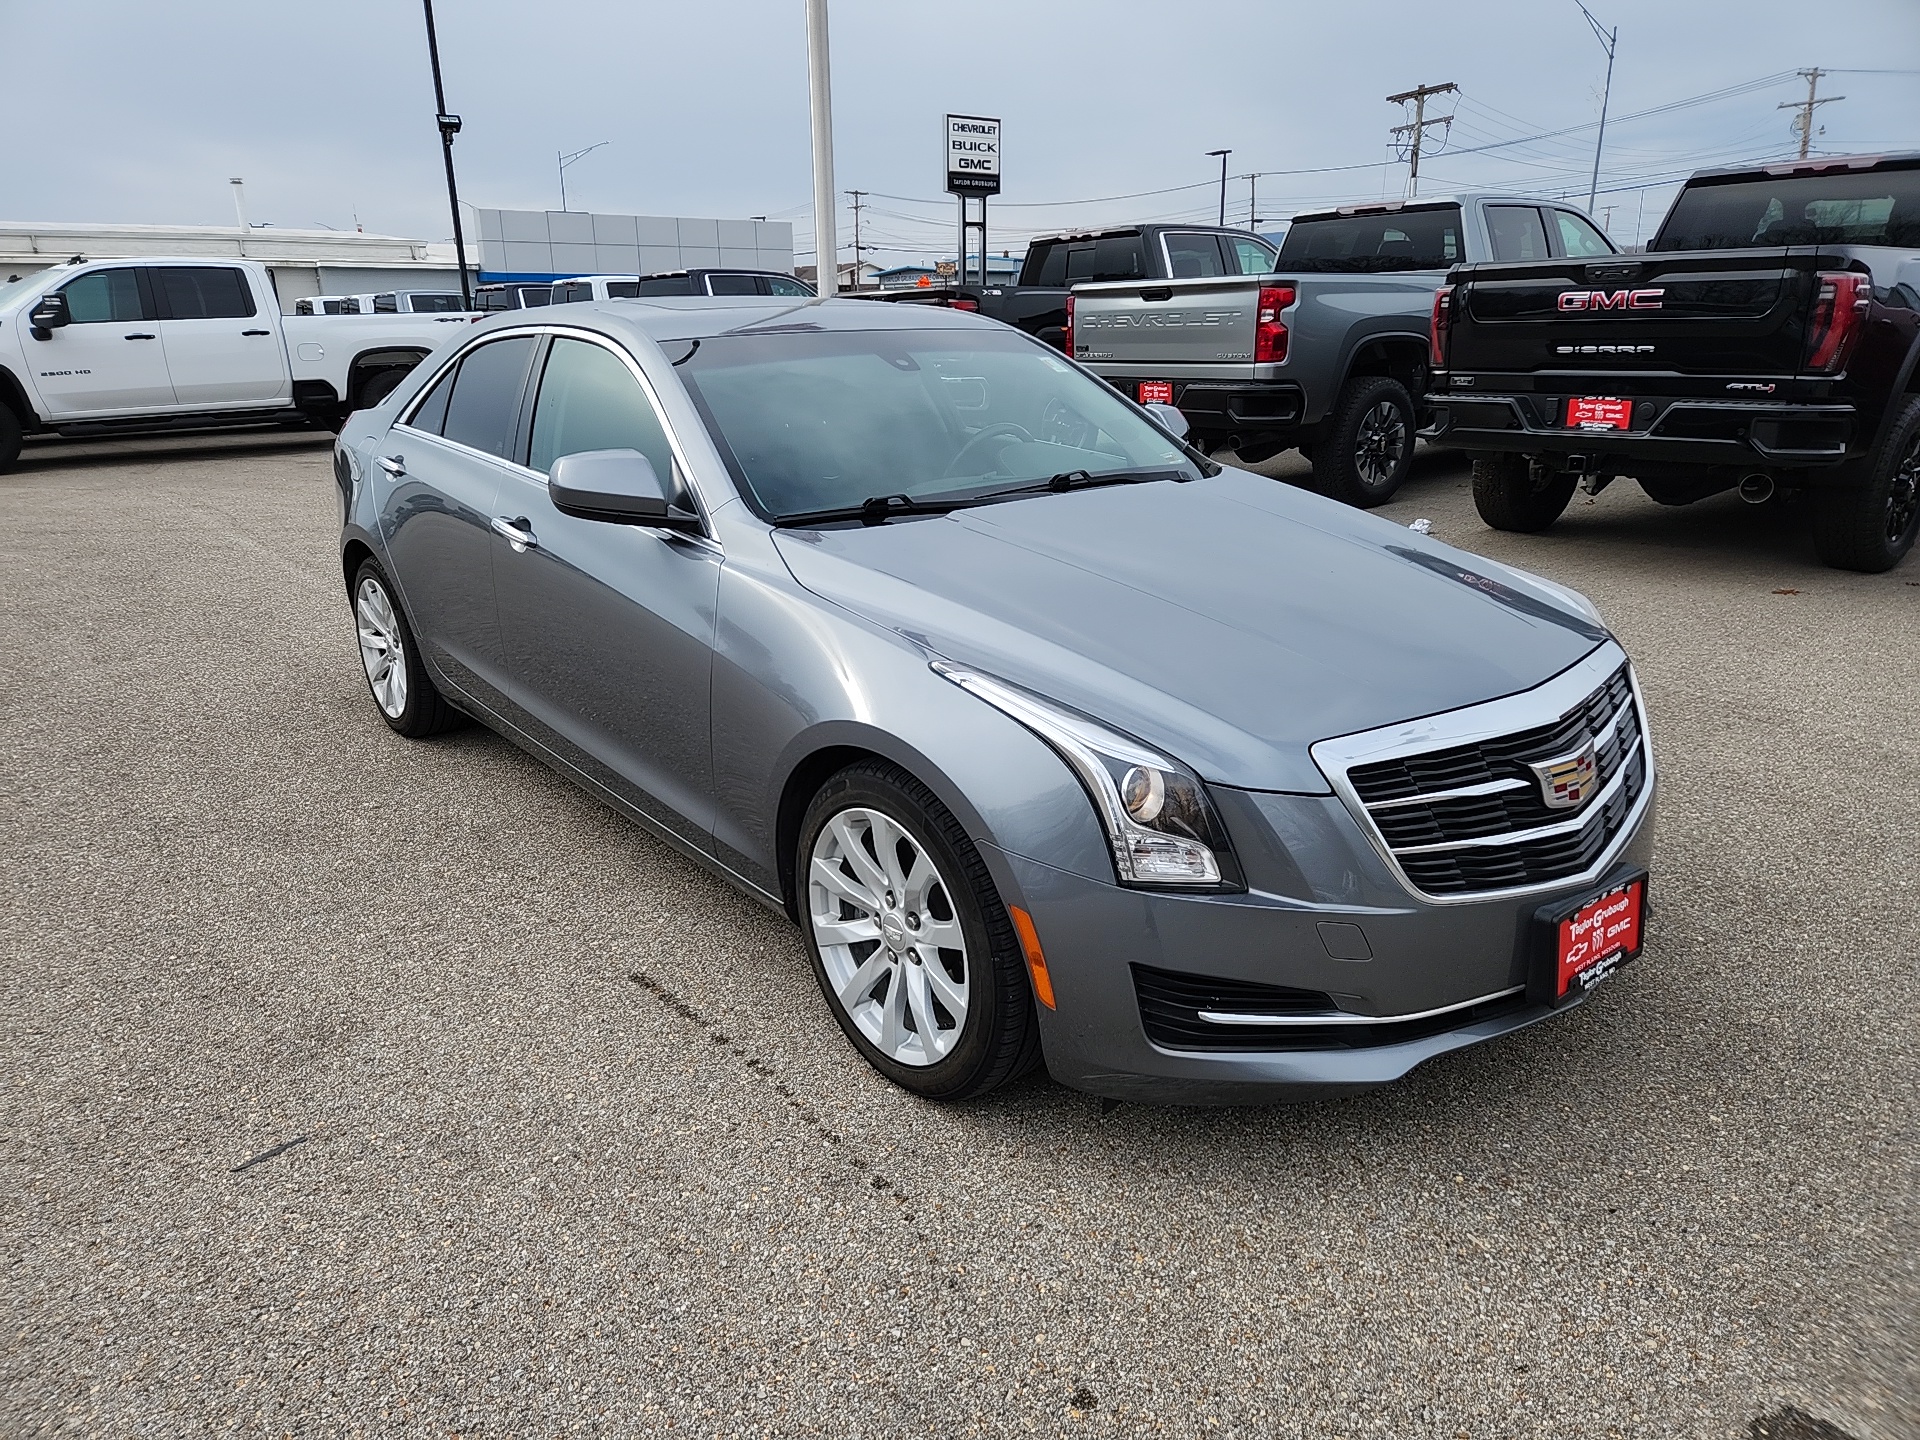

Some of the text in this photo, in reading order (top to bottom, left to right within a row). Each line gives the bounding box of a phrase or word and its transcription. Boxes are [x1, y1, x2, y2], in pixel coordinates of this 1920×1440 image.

[952, 122, 997, 135] CHEVROLET
[952, 140, 997, 153] BUICK
[958, 157, 992, 171] GMC
[1558, 288, 1665, 312] GMC
[1082, 310, 1242, 328] CHEVROLET
[1556, 345, 1655, 354] SIERRA
[1569, 896, 1629, 942] Taylor Grubaugh
[1607, 917, 1631, 938] GMC
[1578, 951, 1622, 987] Taylor Grubaugh
